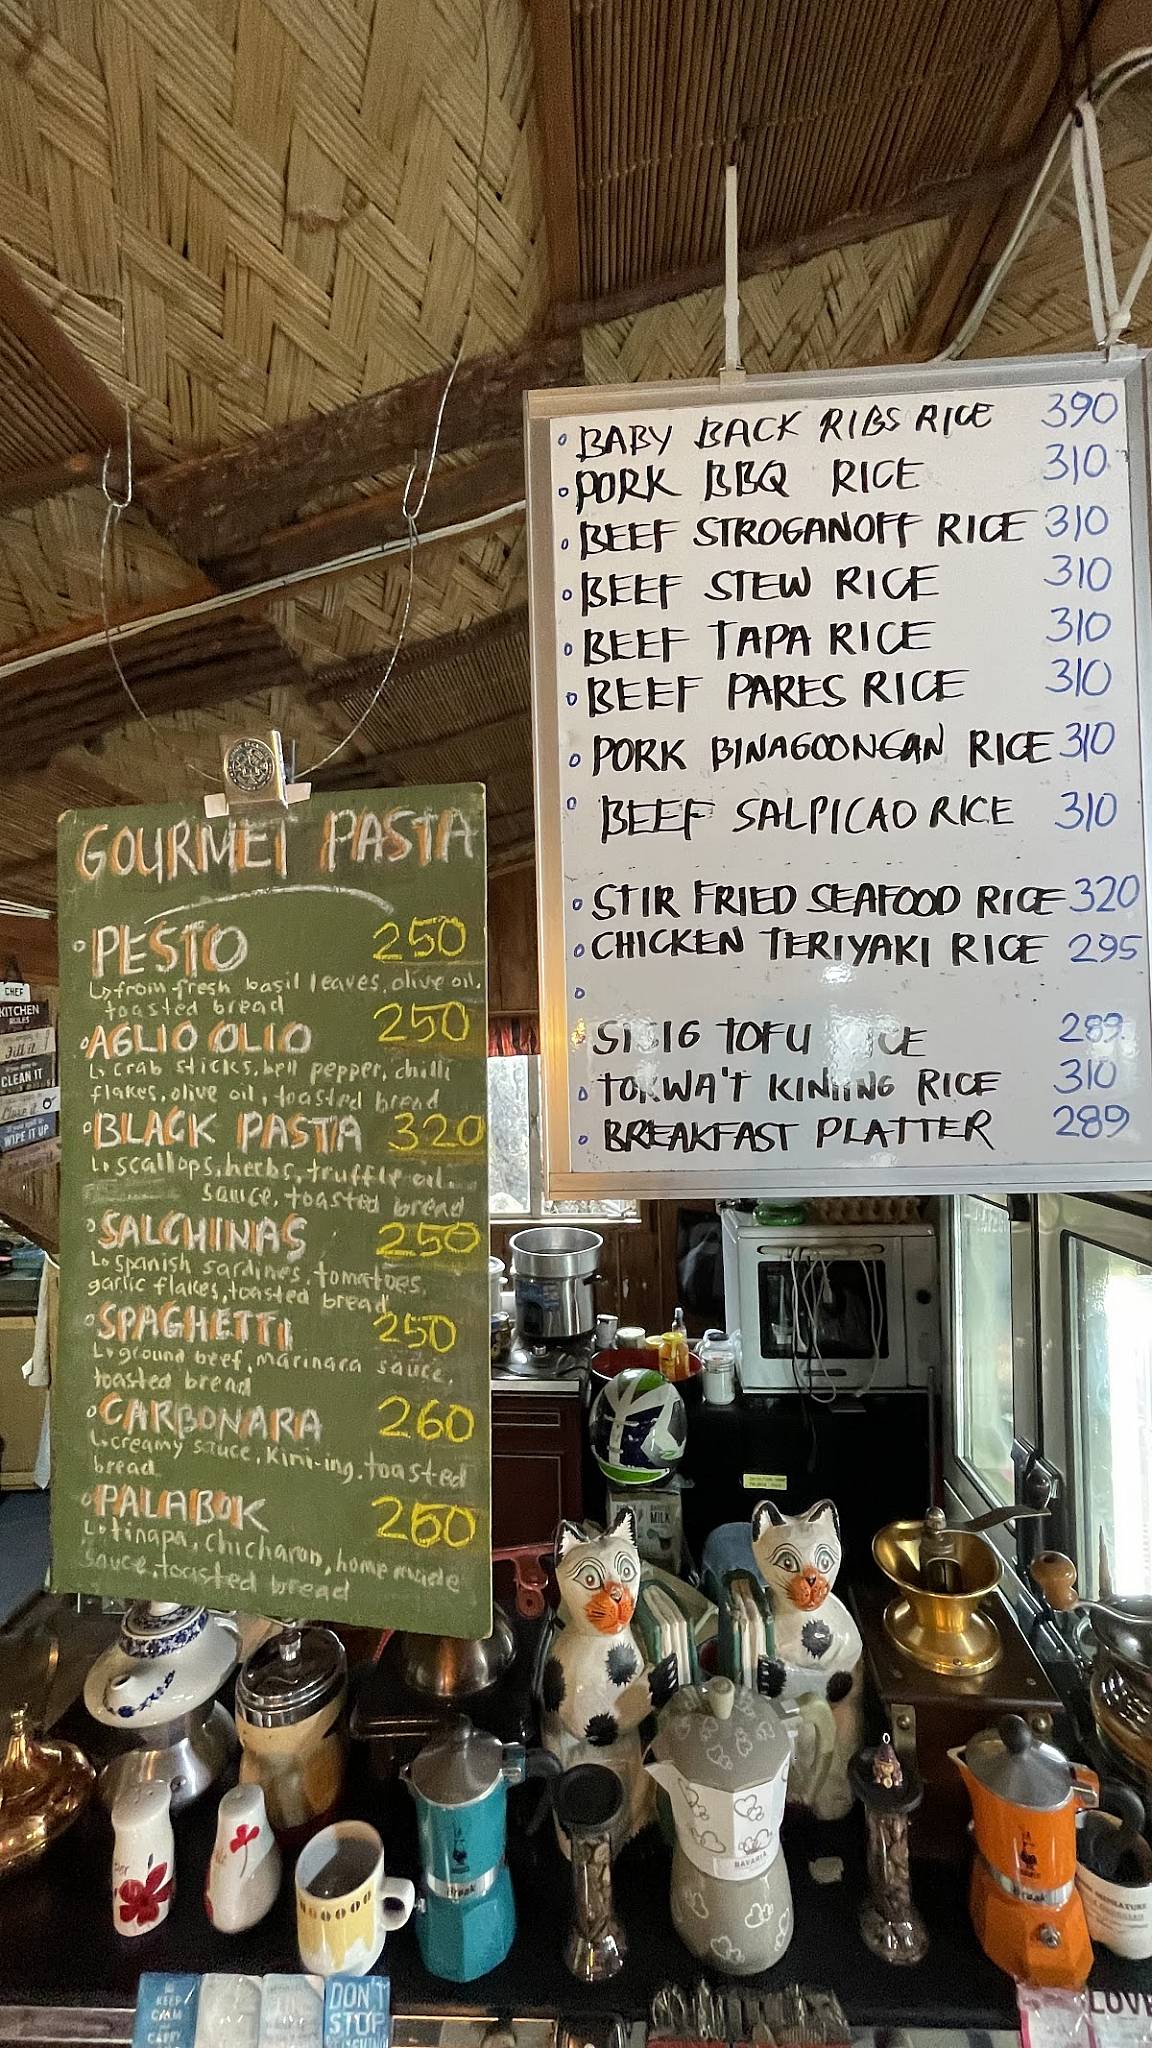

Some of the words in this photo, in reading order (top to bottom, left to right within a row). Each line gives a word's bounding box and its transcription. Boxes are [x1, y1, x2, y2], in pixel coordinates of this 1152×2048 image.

[576, 425, 673, 462] BABY
[694, 410, 802, 449] BACK
[820, 405, 900, 441] RIBS
[915, 402, 995, 436] RICE
[1041, 391, 1118, 428] 390
[576, 464, 682, 515] PORK
[704, 460, 790, 501] BBQ
[832, 457, 924, 497] RICE
[1043, 444, 1107, 485] 310
[580, 519, 681, 560] BEEF
[693, 511, 924, 548] STROGANOFF
[937, 509, 1038, 547] RICE
[1045, 505, 1109, 542] 310
[581, 571, 683, 616] BEEF
[704, 566, 811, 601] STEW
[836, 564, 940, 601] RICE
[1043, 555, 1111, 592] 310
[583, 627, 690, 667] BEEF
[707, 620, 812, 660] TAPA
[829, 620, 936, 656] RICE
[1046, 606, 1112, 646] 310
[587, 675, 703, 717] BEEF
[728, 672, 847, 711] PARES
[863, 669, 970, 707] RICE
[1045, 657, 1112, 697] 310
[592, 735, 687, 777] PORK
[712, 722, 944, 772] BINAGOONGAN
[969, 729, 1055, 768] RICE
[1059, 721, 1115, 763] 310
[601, 795, 715, 844] BEEF
[732, 795, 917, 834] SALPICAO
[929, 794, 1015, 828] RICE
[1054, 791, 1117, 833] 310
[75, 817, 292, 884] GOURMET
[320, 804, 478, 873] PASTA
[591, 884, 681, 921] STIR
[694, 880, 797, 917] FRIED
[806, 883, 961, 917] SEAFOOD
[977, 885, 1067, 918] RICE
[1069, 874, 1140, 913] 320
[92, 920, 248, 979] PESTO
[373, 916, 466, 960] 250
[591, 926, 744, 960] CHICKEN
[759, 926, 930, 967] TERIYAKI
[951, 933, 1050, 967] RICE
[1068, 933, 1143, 964] 295
[105, 997, 199, 1021] toasted
[213, 995, 283, 1015] bread
[114, 981, 167, 999] from
[172, 979, 231, 1000] fresh
[246, 972, 299, 993] basil
[391, 968, 444, 991] olive
[85, 1020, 198, 1060] AGLIO
[208, 1019, 311, 1054] OLIO
[374, 1001, 469, 1043] 250
[592, 1020, 701, 1055] SIIG
[715, 1017, 812, 1054] TOFU
[1058, 1012, 1124, 1043] 289
[1, 1069, 32, 1088] CLEAN
[33, 1067, 43, 1081] IT
[114, 1060, 162, 1076] crab
[917, 1068, 1002, 1106] RICE
[1053, 1059, 1117, 1095] 310
[171, 1083, 217, 1102] olive
[274, 1084, 362, 1110] toasted
[375, 1088, 440, 1113] bread
[4, 1130, 26, 1148] WIPE
[28, 1127, 36, 1140] IT
[38, 1123, 49, 1138] UP
[93, 1105, 217, 1150] BLACK
[236, 1111, 362, 1154] PASTA
[388, 1112, 485, 1150] 320
[604, 1118, 800, 1153] BREAKFAST
[816, 1109, 995, 1150] PLATTER
[1053, 1104, 1130, 1139] 289
[284, 1187, 380, 1214] toasted
[393, 1197, 464, 1217] bread
[98, 1209, 307, 1262] SALCHINAS
[376, 1222, 480, 1257] 250
[88, 1277, 146, 1296] garlic
[229, 1281, 309, 1304] toasted
[97, 1301, 293, 1350] SPAGHETTI
[373, 1312, 457, 1353] 250
[95, 1367, 172, 1390] toasted
[184, 1369, 251, 1396] bread
[119, 1347, 185, 1365] ground
[257, 1352, 361, 1373] marinara
[98, 1391, 322, 1443] CARBONARA
[378, 1395, 475, 1443] 260
[94, 1455, 157, 1475] bread
[111, 1436, 183, 1459] creamy
[364, 1450, 466, 1488] toasted
[94, 1484, 269, 1533] PALABOK
[329, 1978, 389, 2010] DON'T
[329, 2011, 386, 2036] STOP
